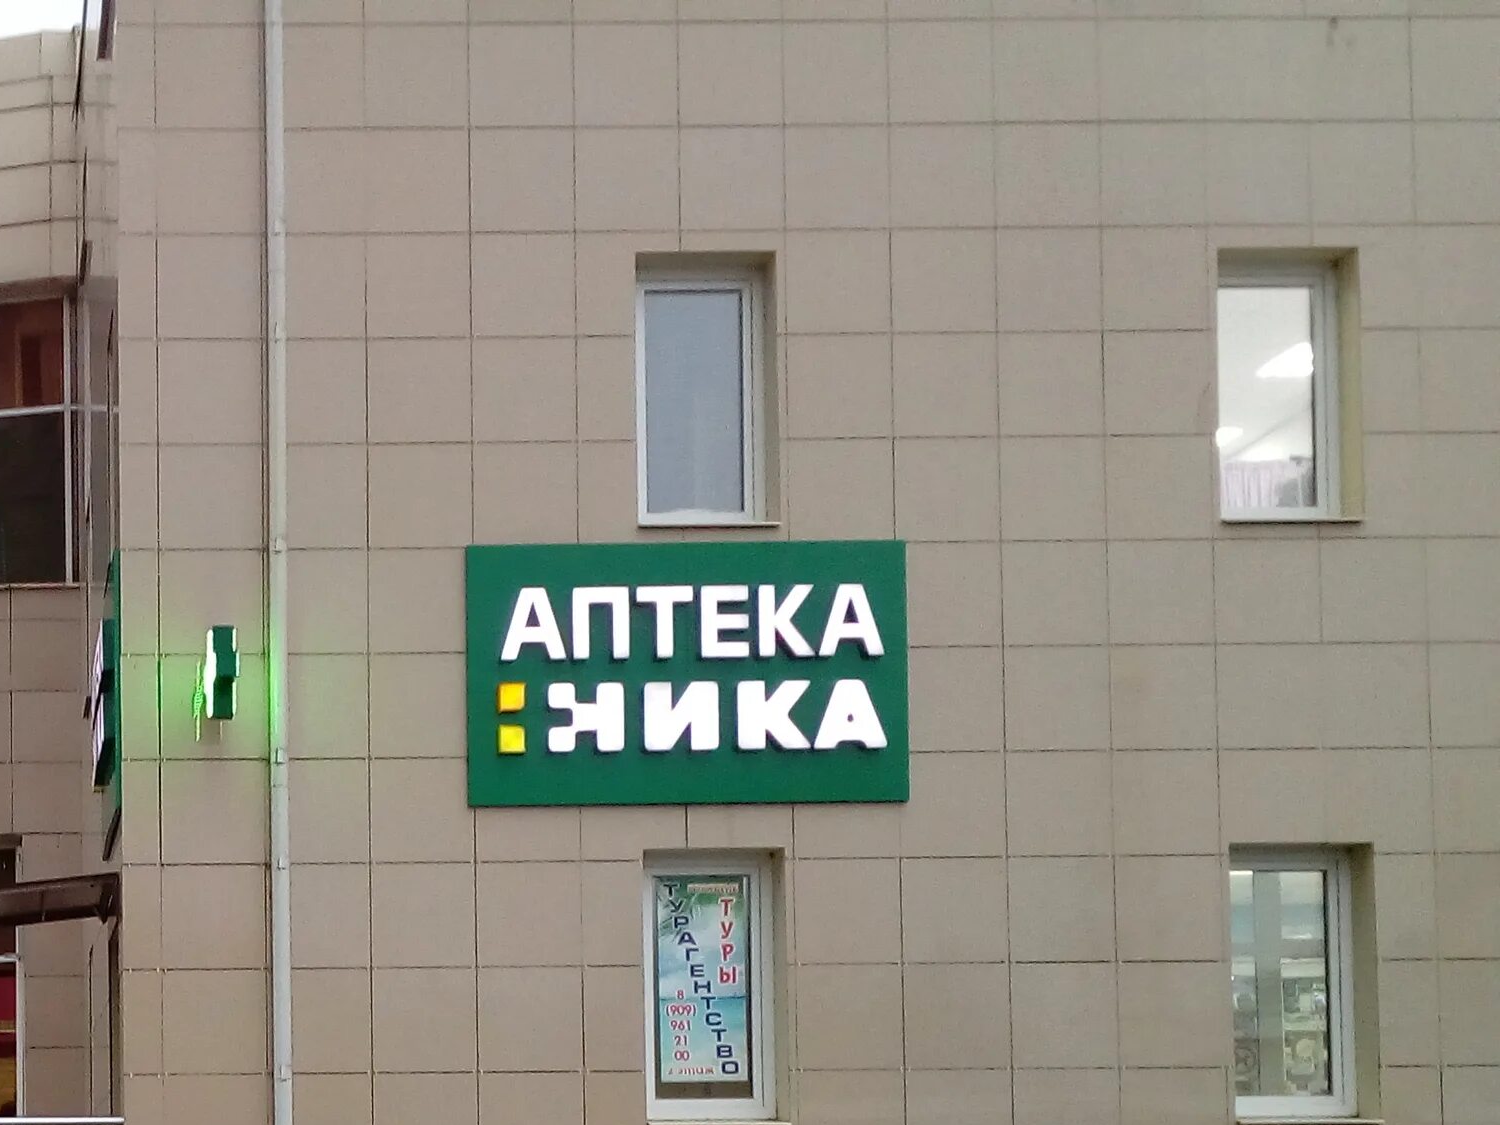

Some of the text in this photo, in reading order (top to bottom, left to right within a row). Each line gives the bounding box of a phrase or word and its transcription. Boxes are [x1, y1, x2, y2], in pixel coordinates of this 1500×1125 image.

[500, 583, 885, 660] АПТЕКА
[718, 898, 737, 985] ТУРЫ
[677, 989, 685, 1000] 8
[666, 1004, 697, 1017] (909)
[670, 1020, 691, 1031] 961
[674, 1050, 690, 1061] 00
